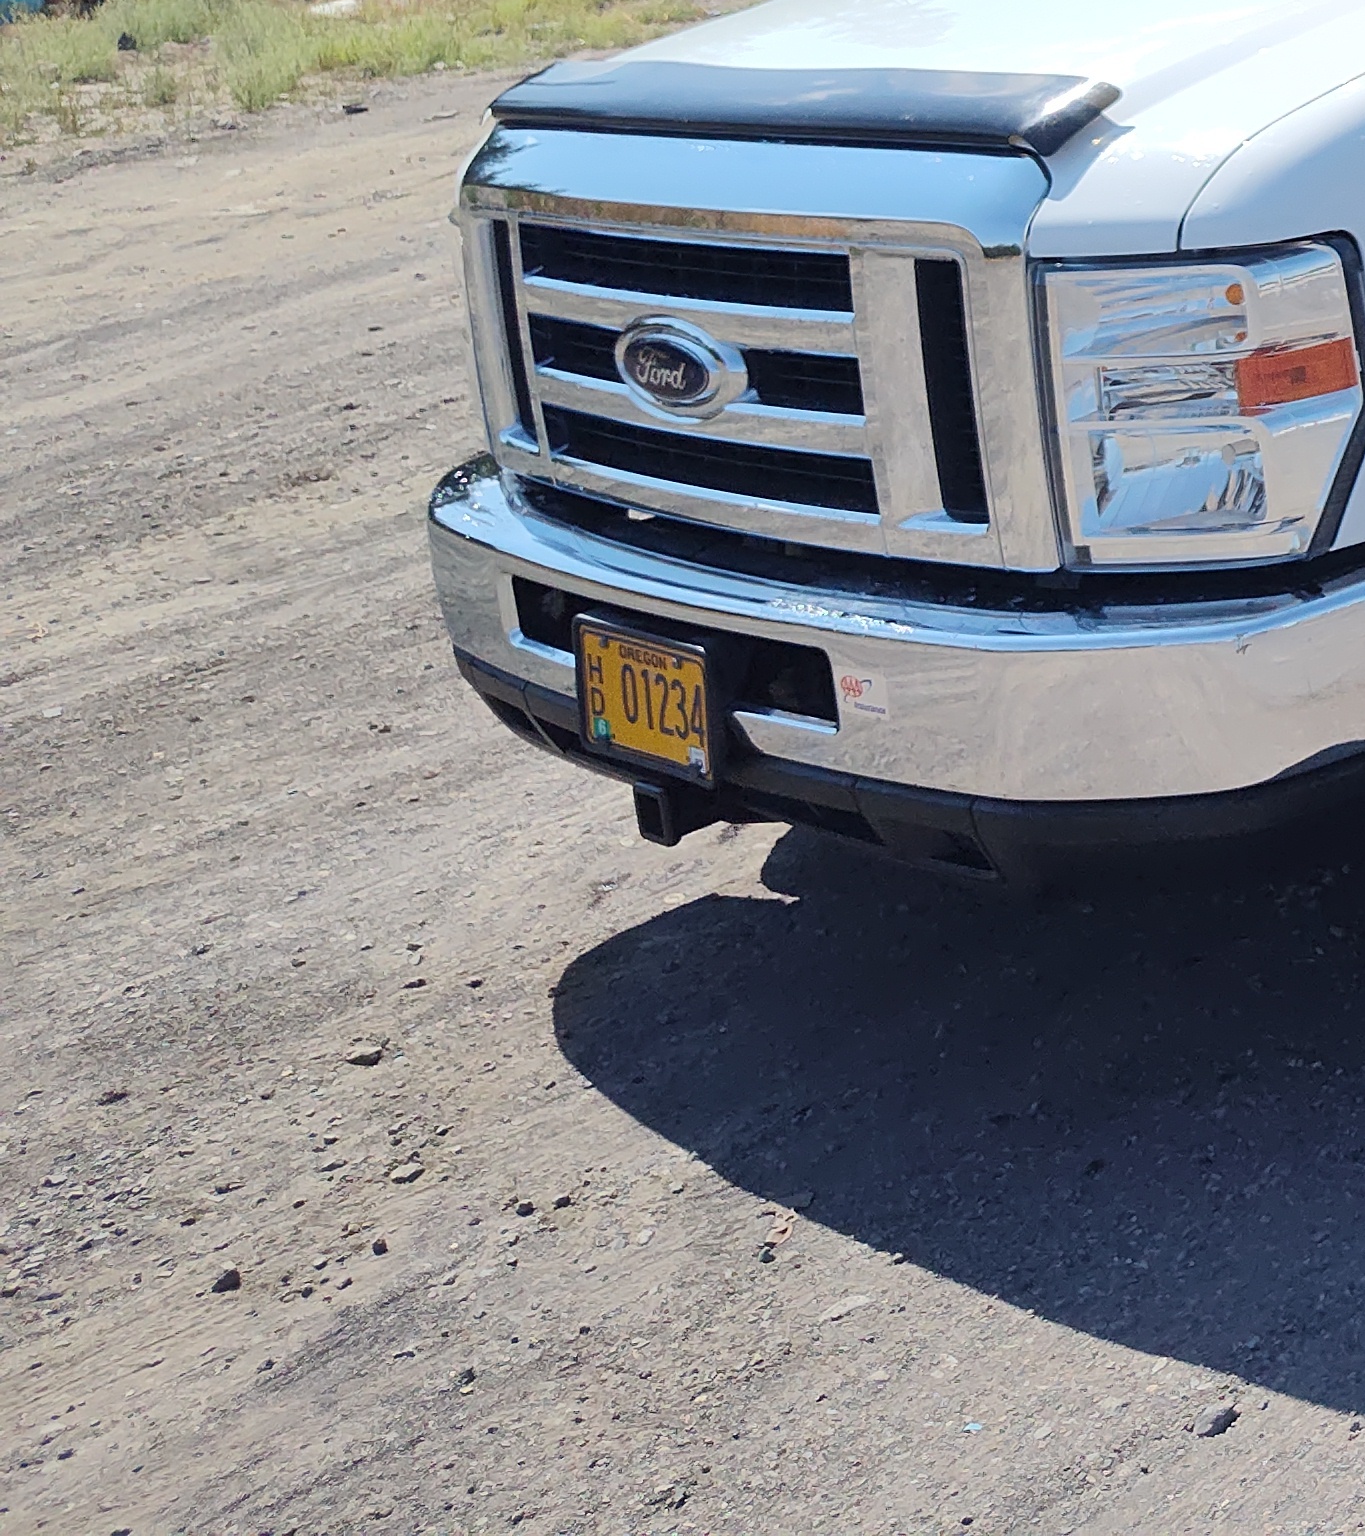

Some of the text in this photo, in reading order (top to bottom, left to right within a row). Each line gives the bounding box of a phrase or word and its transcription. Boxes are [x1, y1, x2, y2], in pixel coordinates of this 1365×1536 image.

[636, 347, 686, 390] Ford
[620, 644, 667, 670] OREGON
[621, 664, 704, 748] 01234
